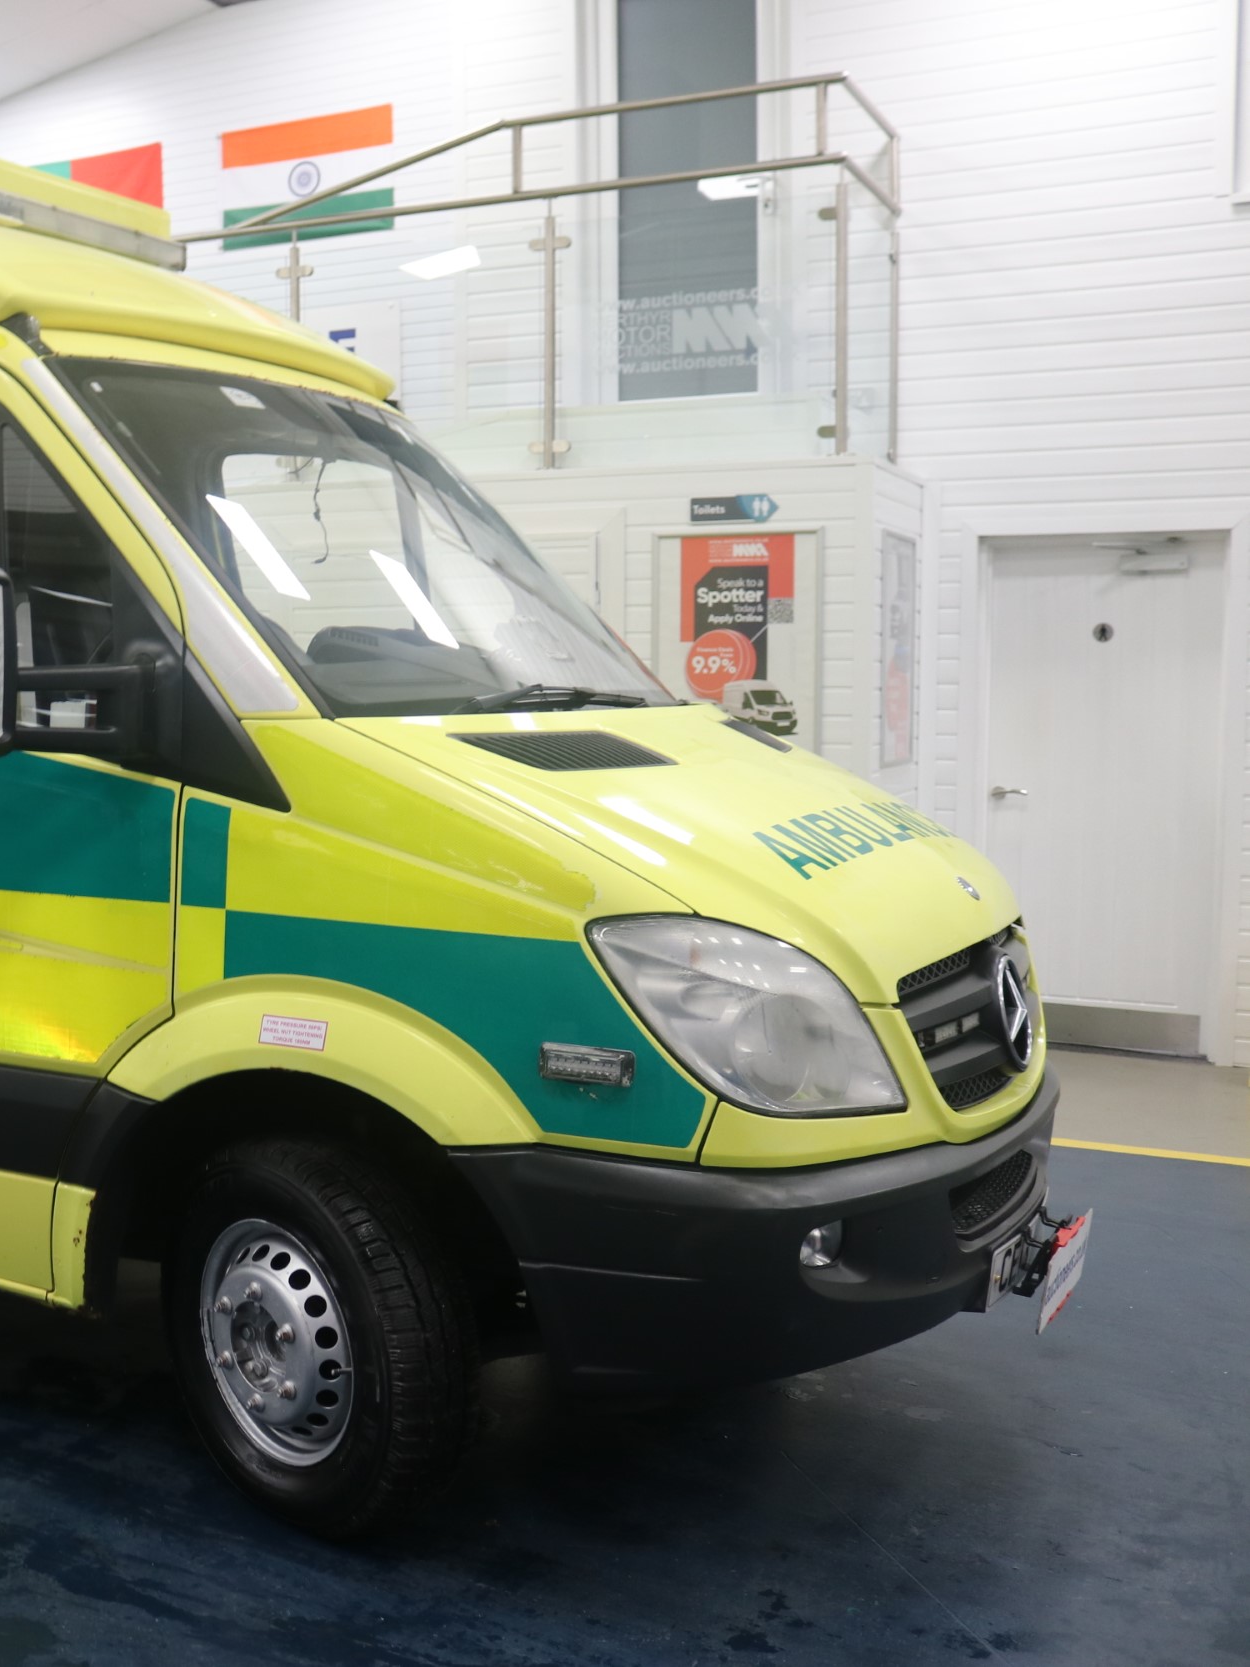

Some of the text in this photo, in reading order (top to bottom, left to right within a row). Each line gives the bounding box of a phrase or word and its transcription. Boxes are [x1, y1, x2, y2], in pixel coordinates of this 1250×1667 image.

[693, 504, 726, 515] Toilets
[717, 578, 764, 589] Speak to a
[696, 587, 765, 607] Spotter
[733, 604, 756, 614] Today
[707, 613, 764, 624] Apply Online
[692, 655, 737, 674] 9.9%
[292, 1030, 323, 1039] TIGHTENING
